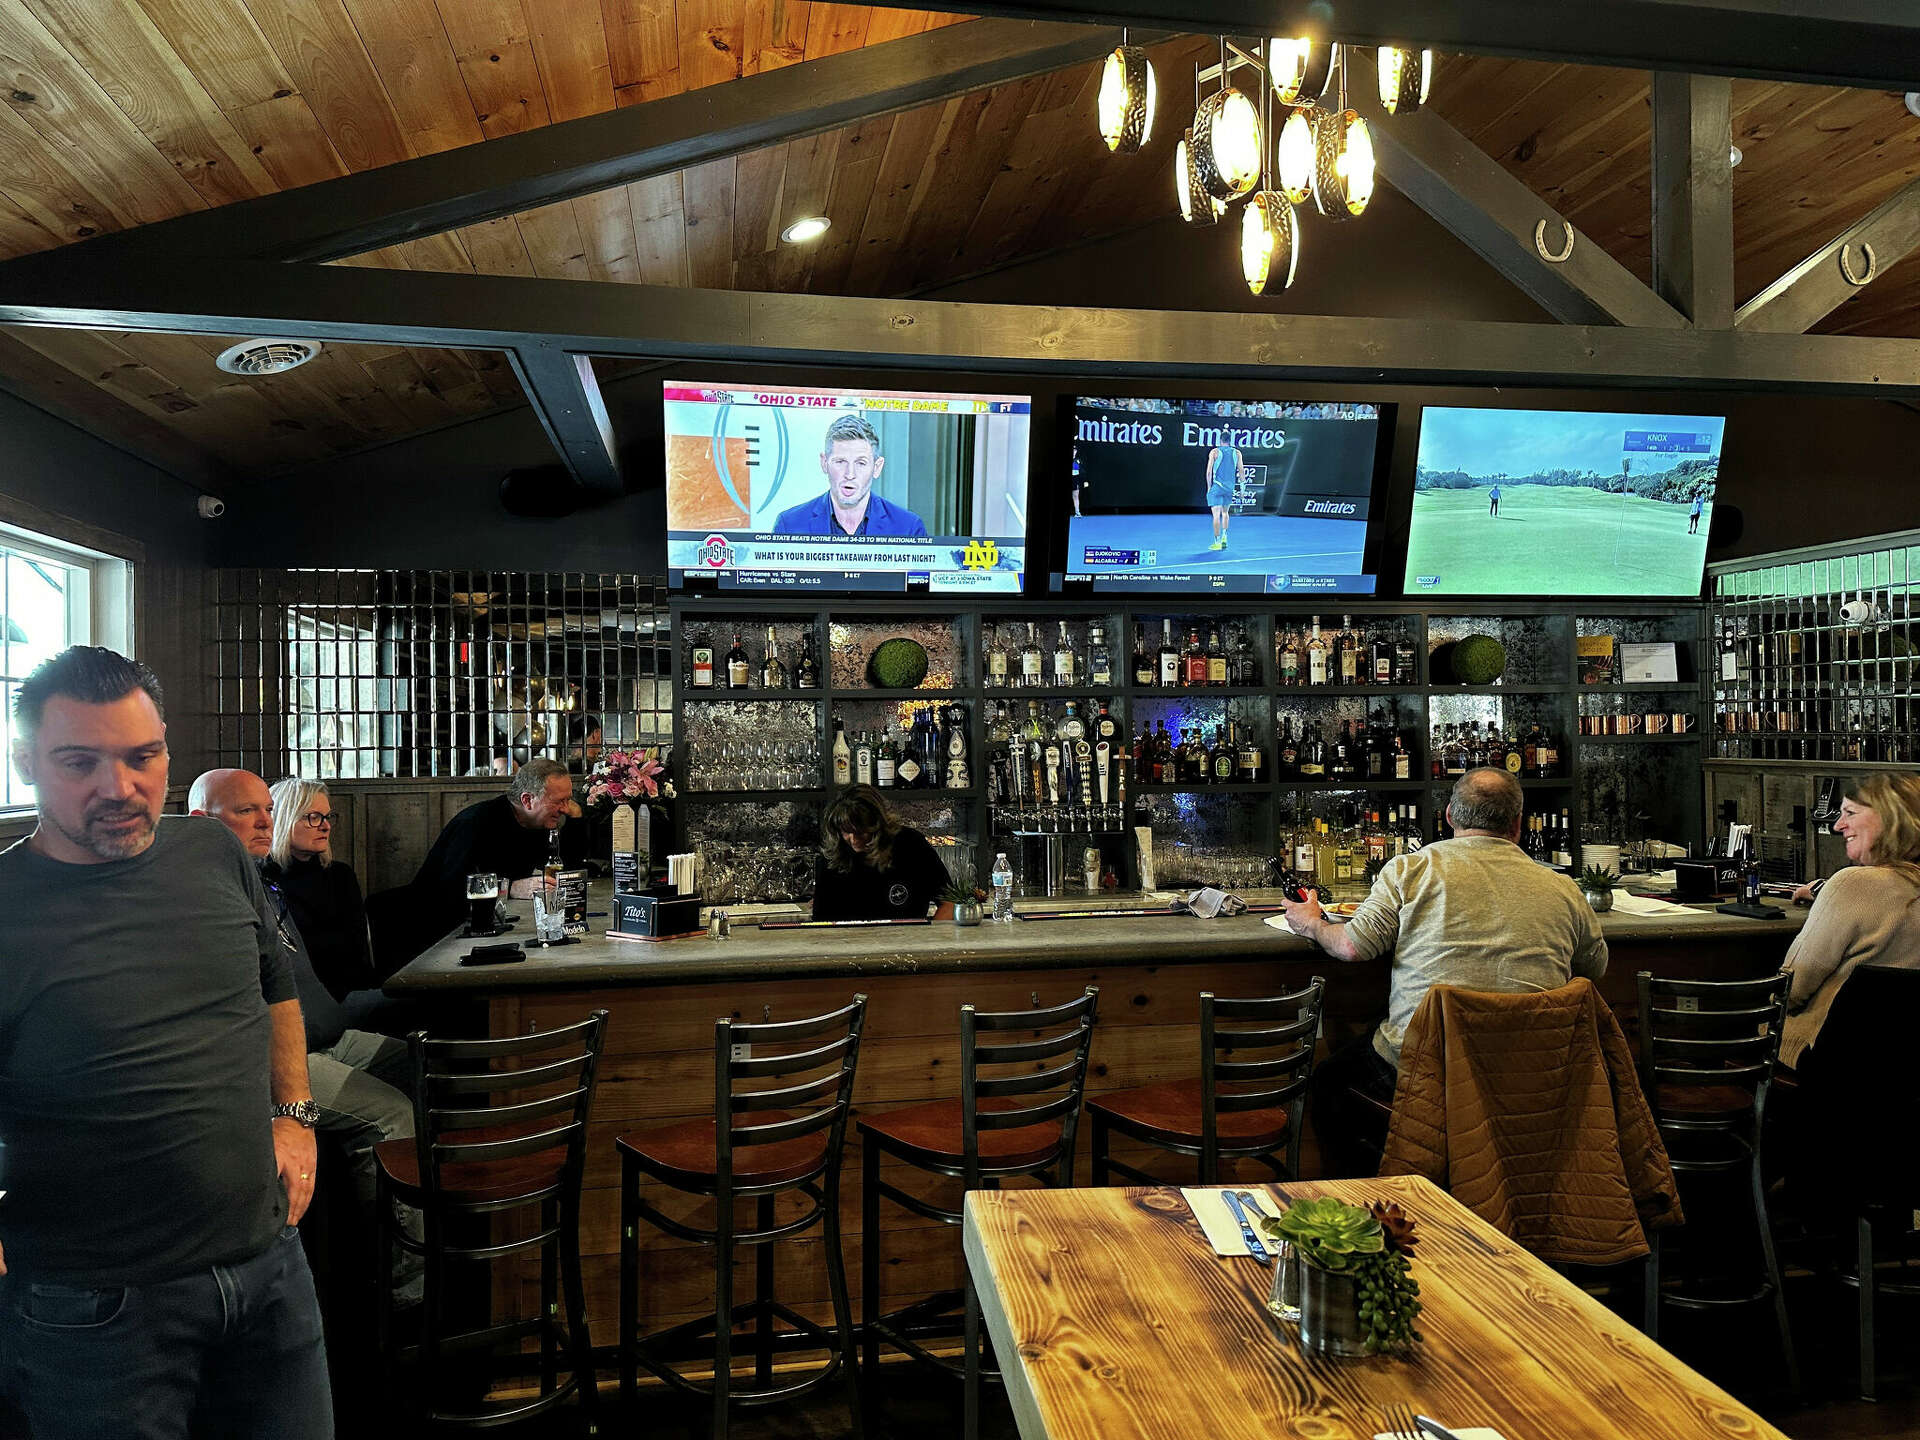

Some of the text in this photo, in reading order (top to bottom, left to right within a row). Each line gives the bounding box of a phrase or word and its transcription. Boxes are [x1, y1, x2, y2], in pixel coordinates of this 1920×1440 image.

[759, 394, 794, 406] OHIO
[798, 396, 838, 407] STATE
[865, 399, 949, 412] NOTRE DAME
[1074, 415, 1162, 445] mirates
[1647, 434, 1668, 442] KNOX
[1304, 500, 1356, 514] Emirates
[754, 552, 936, 563] WHAT IS YOUR BIGGEST TAKEAWAY FROM LAST NIGHT?
[562, 924, 586, 936] Modelo
